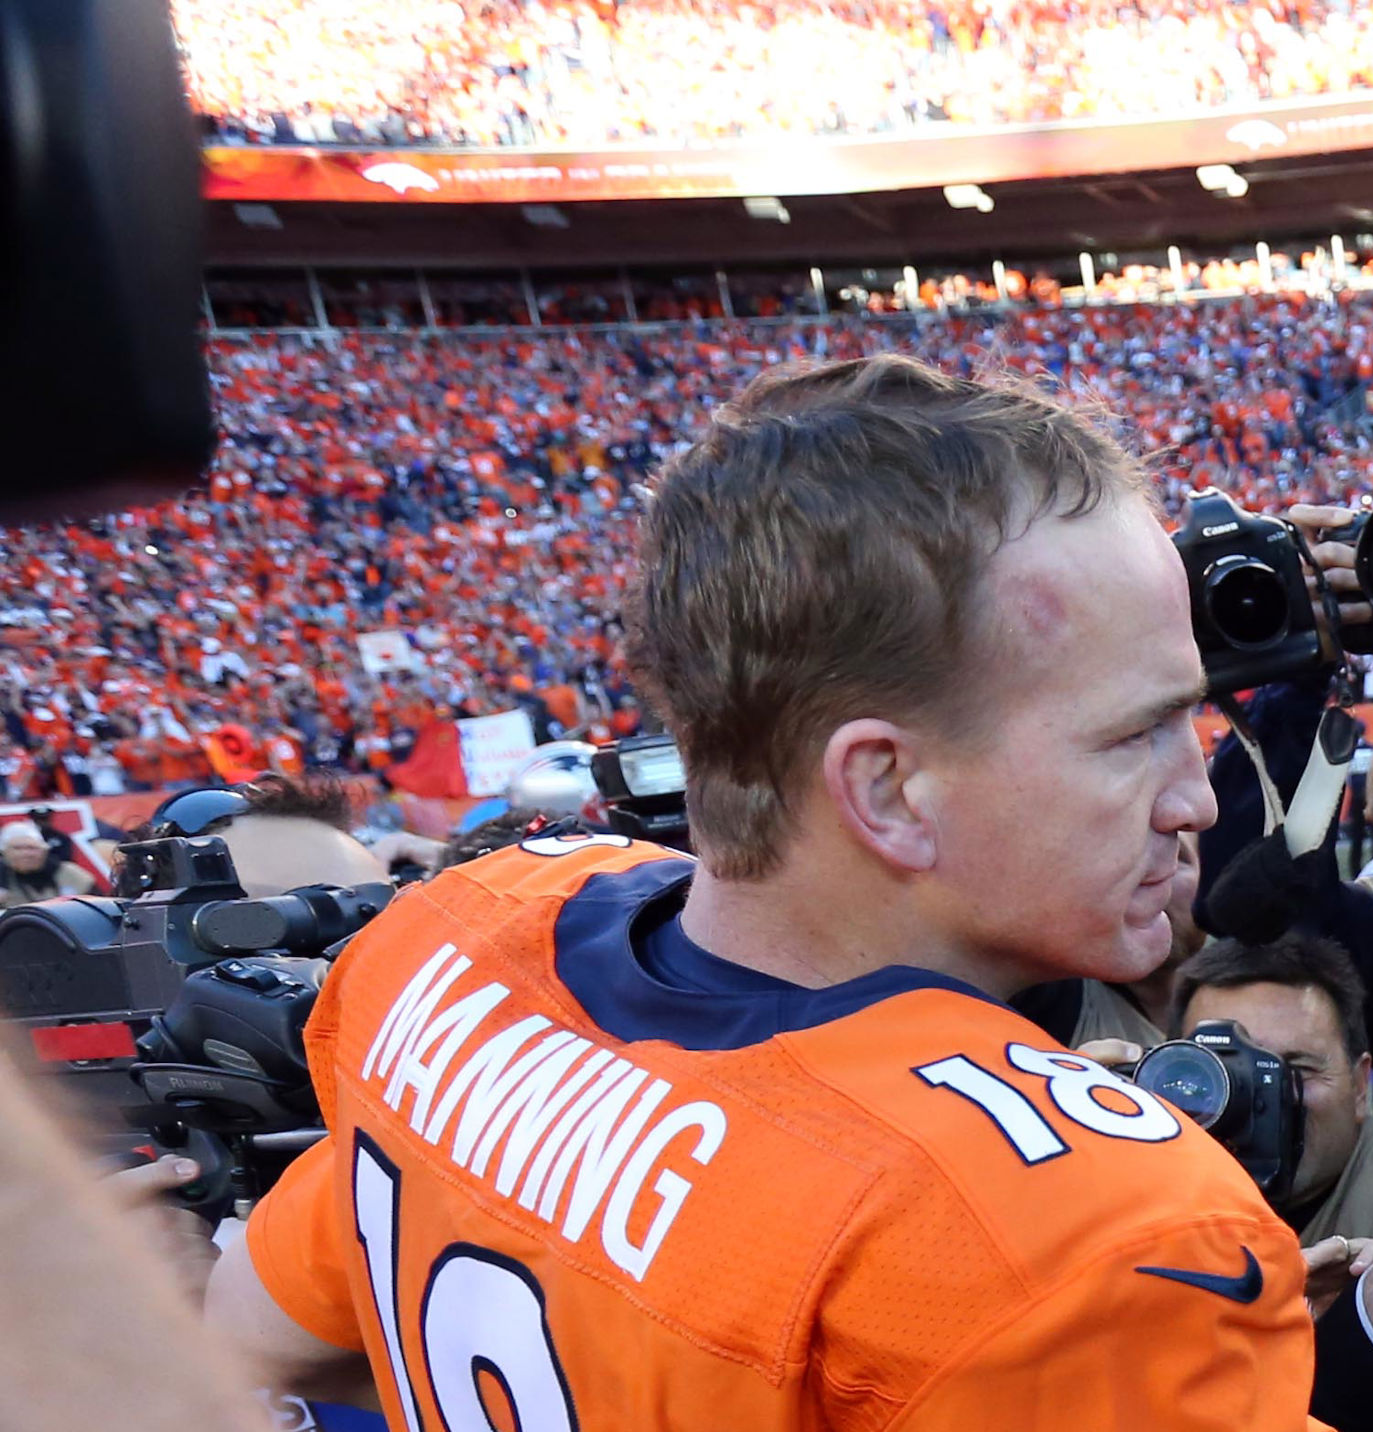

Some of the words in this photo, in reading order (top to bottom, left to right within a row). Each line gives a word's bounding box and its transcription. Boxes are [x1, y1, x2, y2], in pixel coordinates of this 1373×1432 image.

[1202, 522, 1239, 537] Canon
[1195, 1034, 1231, 1044] Canon
[361, 942, 727, 1282] MANNING
[909, 1042, 1182, 1166] 18
